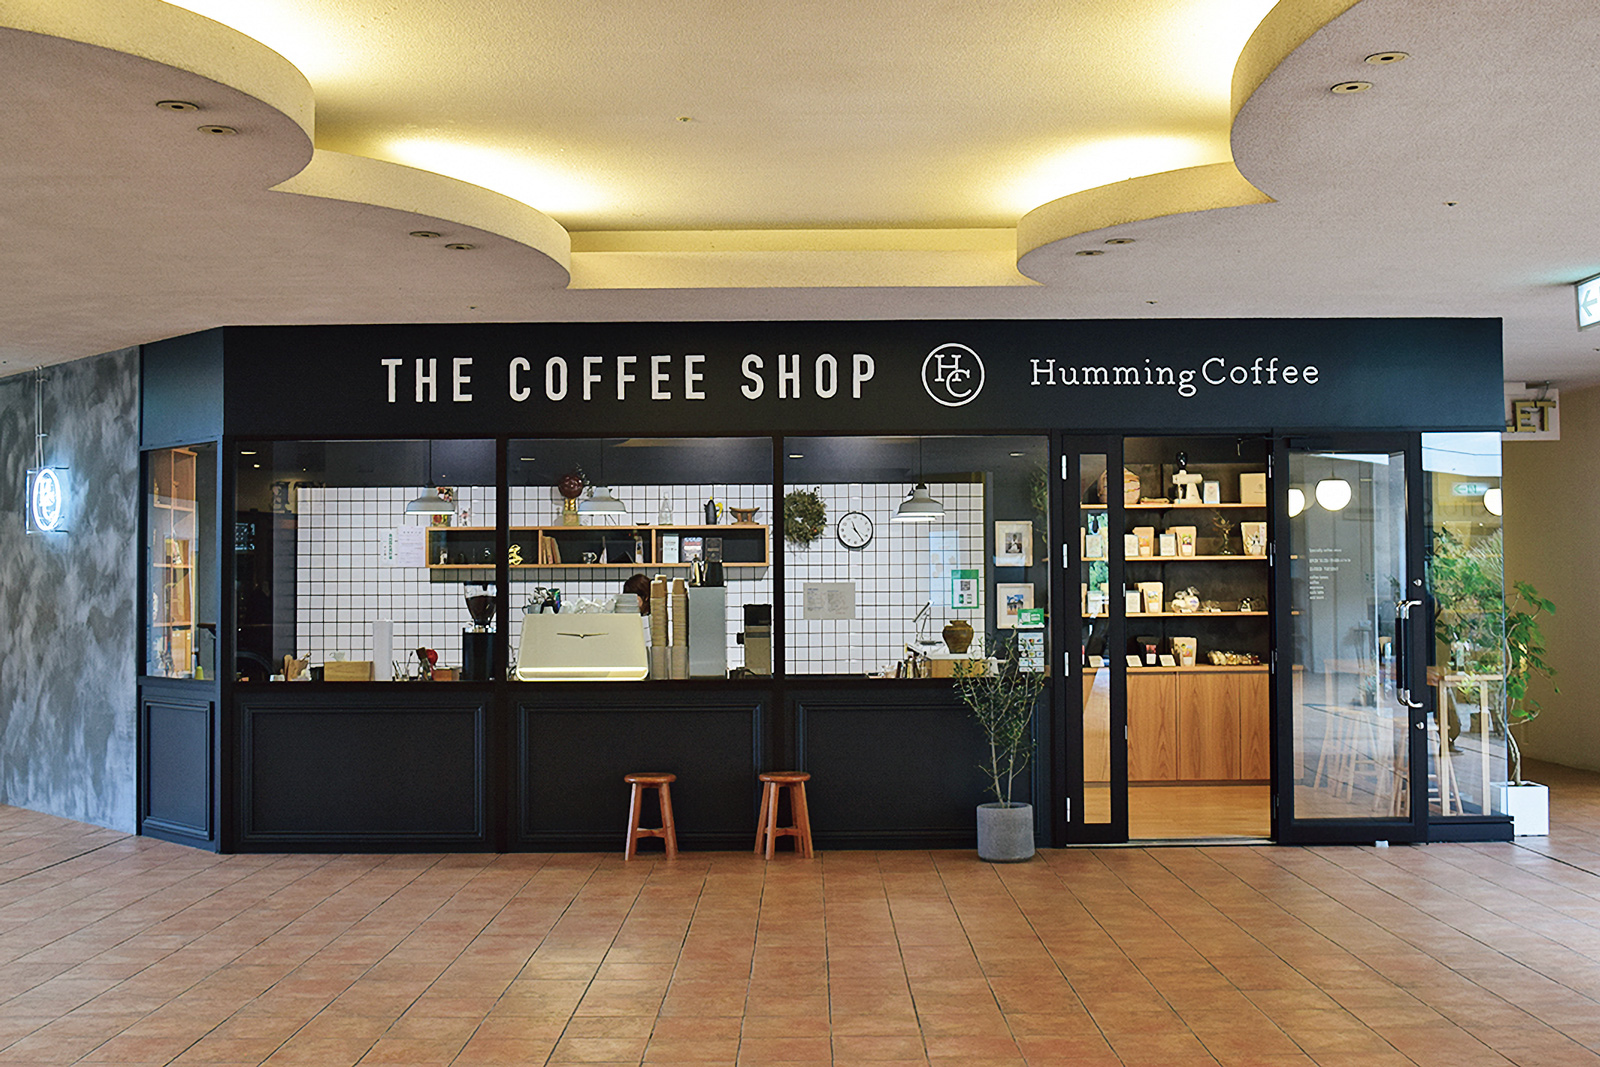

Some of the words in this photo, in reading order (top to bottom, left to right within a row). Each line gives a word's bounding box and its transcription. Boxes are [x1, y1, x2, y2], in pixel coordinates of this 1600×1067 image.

[381, 357, 473, 403] THE
[509, 354, 706, 402] COFFEE
[740, 353, 875, 400] SHOP
[1506, 400, 1556, 432] ET
